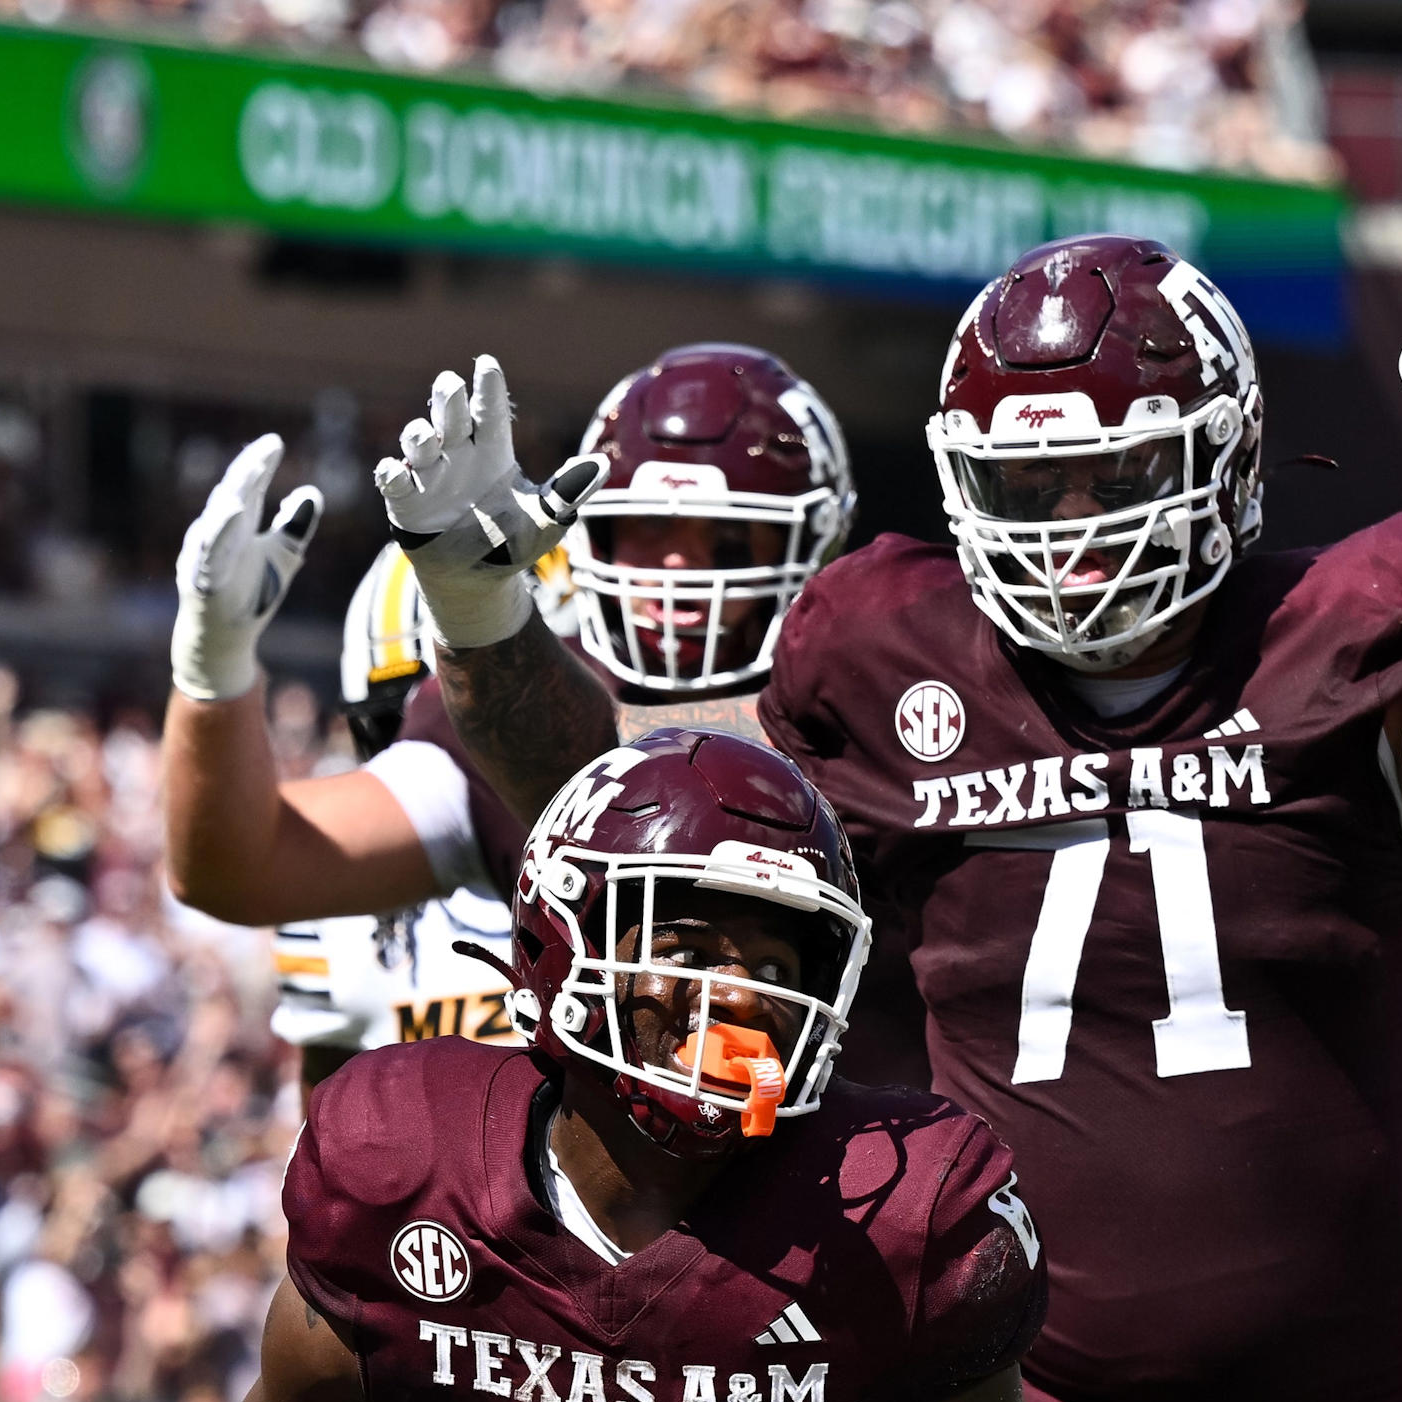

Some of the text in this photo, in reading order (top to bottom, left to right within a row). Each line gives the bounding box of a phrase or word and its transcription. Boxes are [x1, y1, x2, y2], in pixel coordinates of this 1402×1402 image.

[1015, 404, 1066, 429] Aggies
[899, 684, 962, 758] SEC
[913, 743, 1271, 829] TEXAS A&M
[962, 810, 1252, 1085] 71
[394, 1224, 467, 1298] SEC
